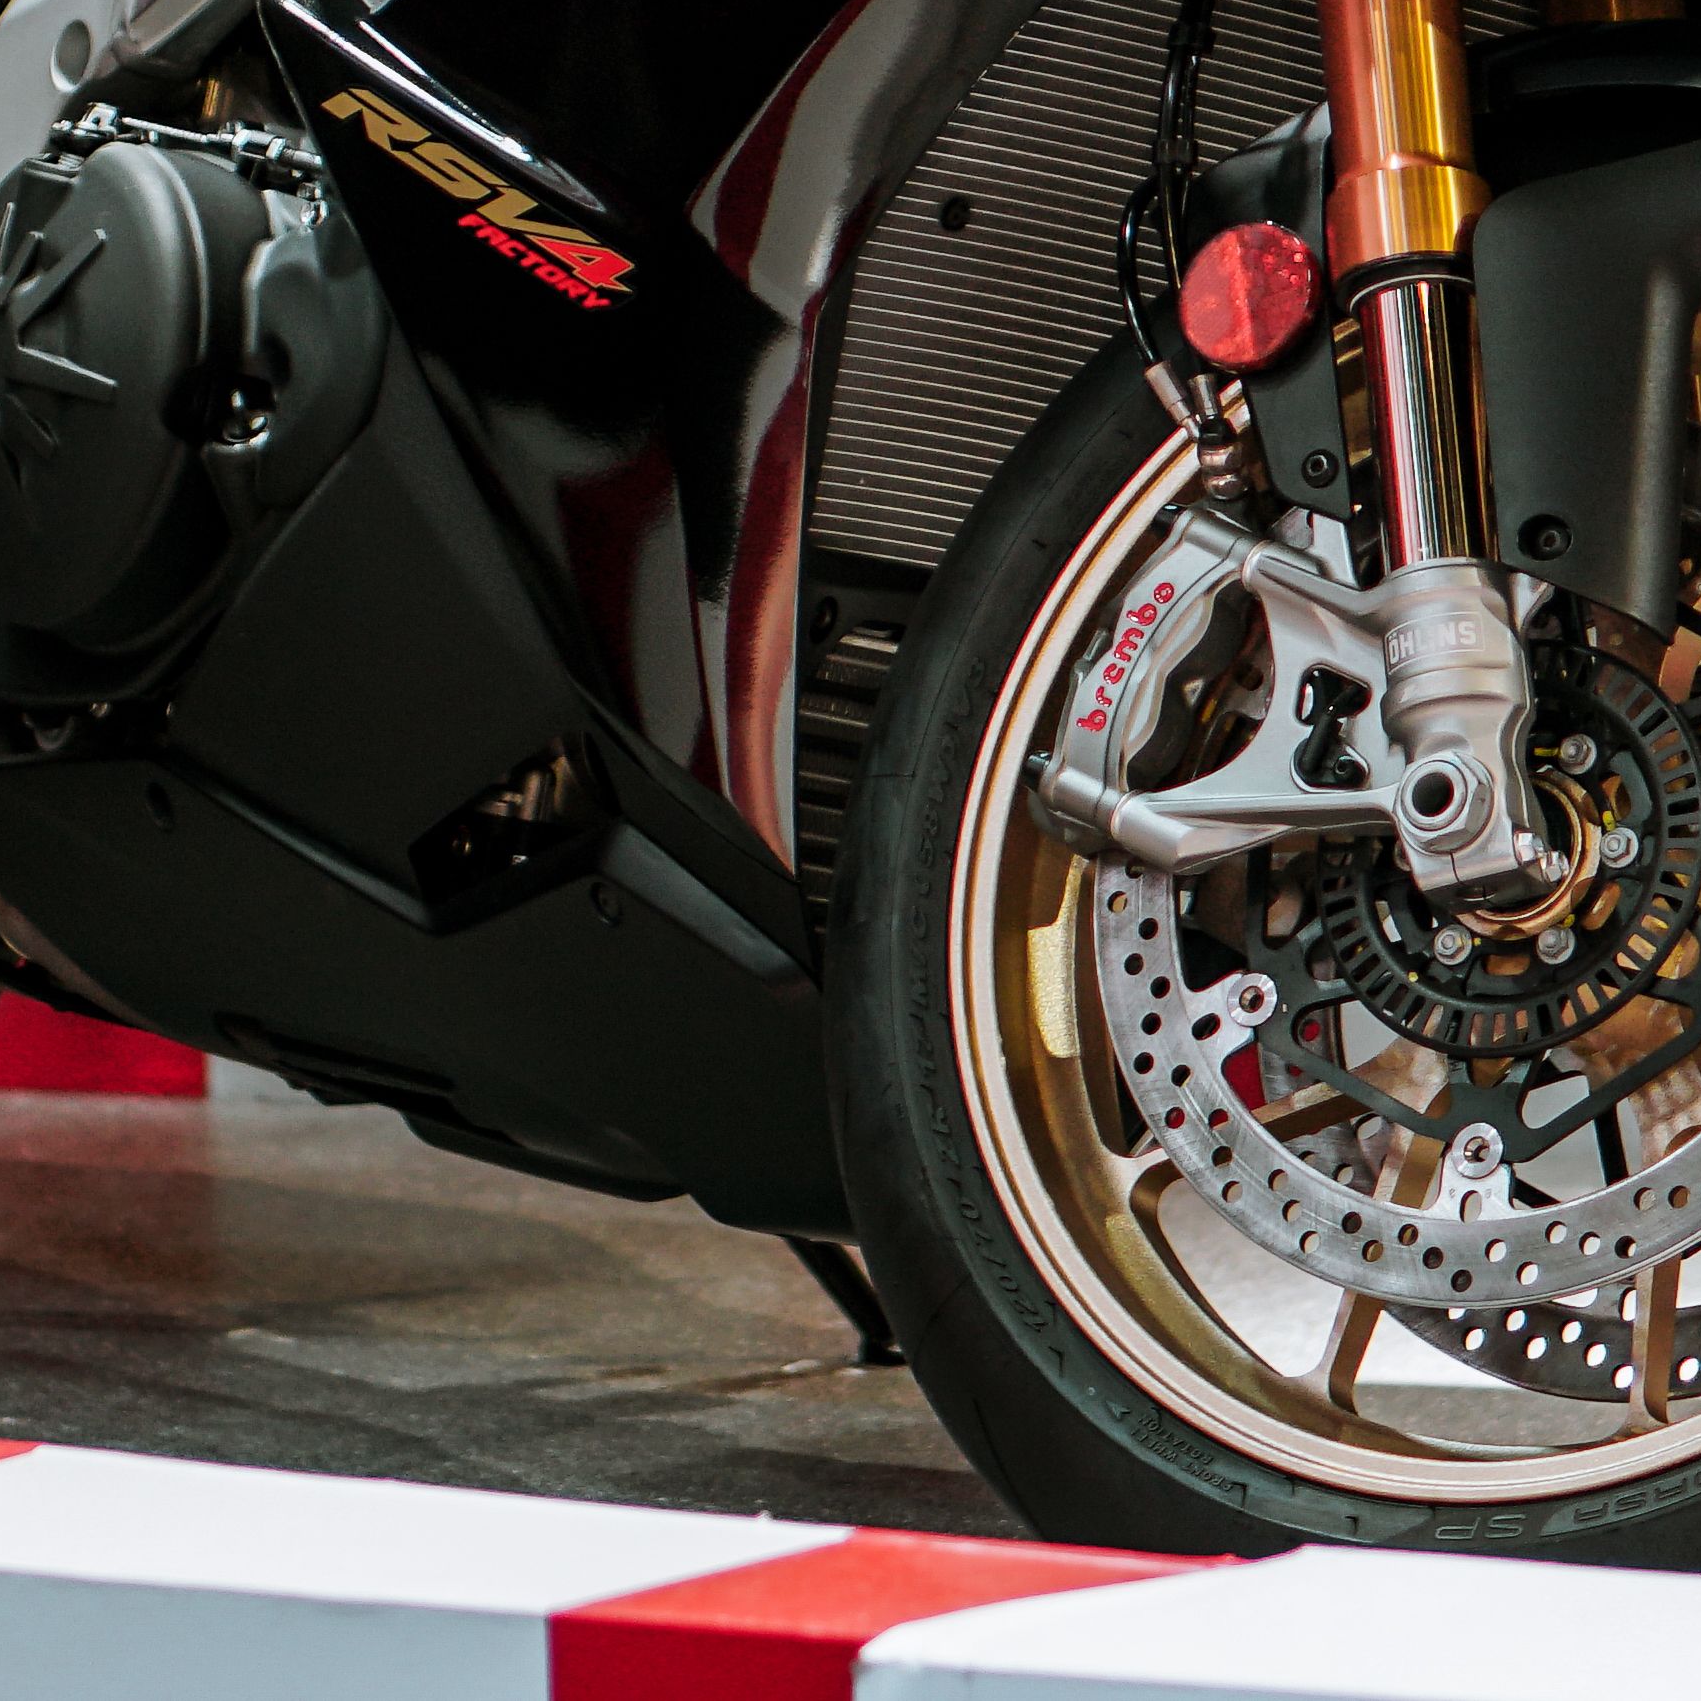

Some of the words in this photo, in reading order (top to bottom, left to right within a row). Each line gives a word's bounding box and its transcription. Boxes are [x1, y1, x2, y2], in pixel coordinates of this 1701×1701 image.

[320, 87, 636, 293] RSV4
[457, 212, 612, 310] FACTORY
[1075, 581, 1175, 732] brembo
[1433, 1512, 1528, 1542] SP
